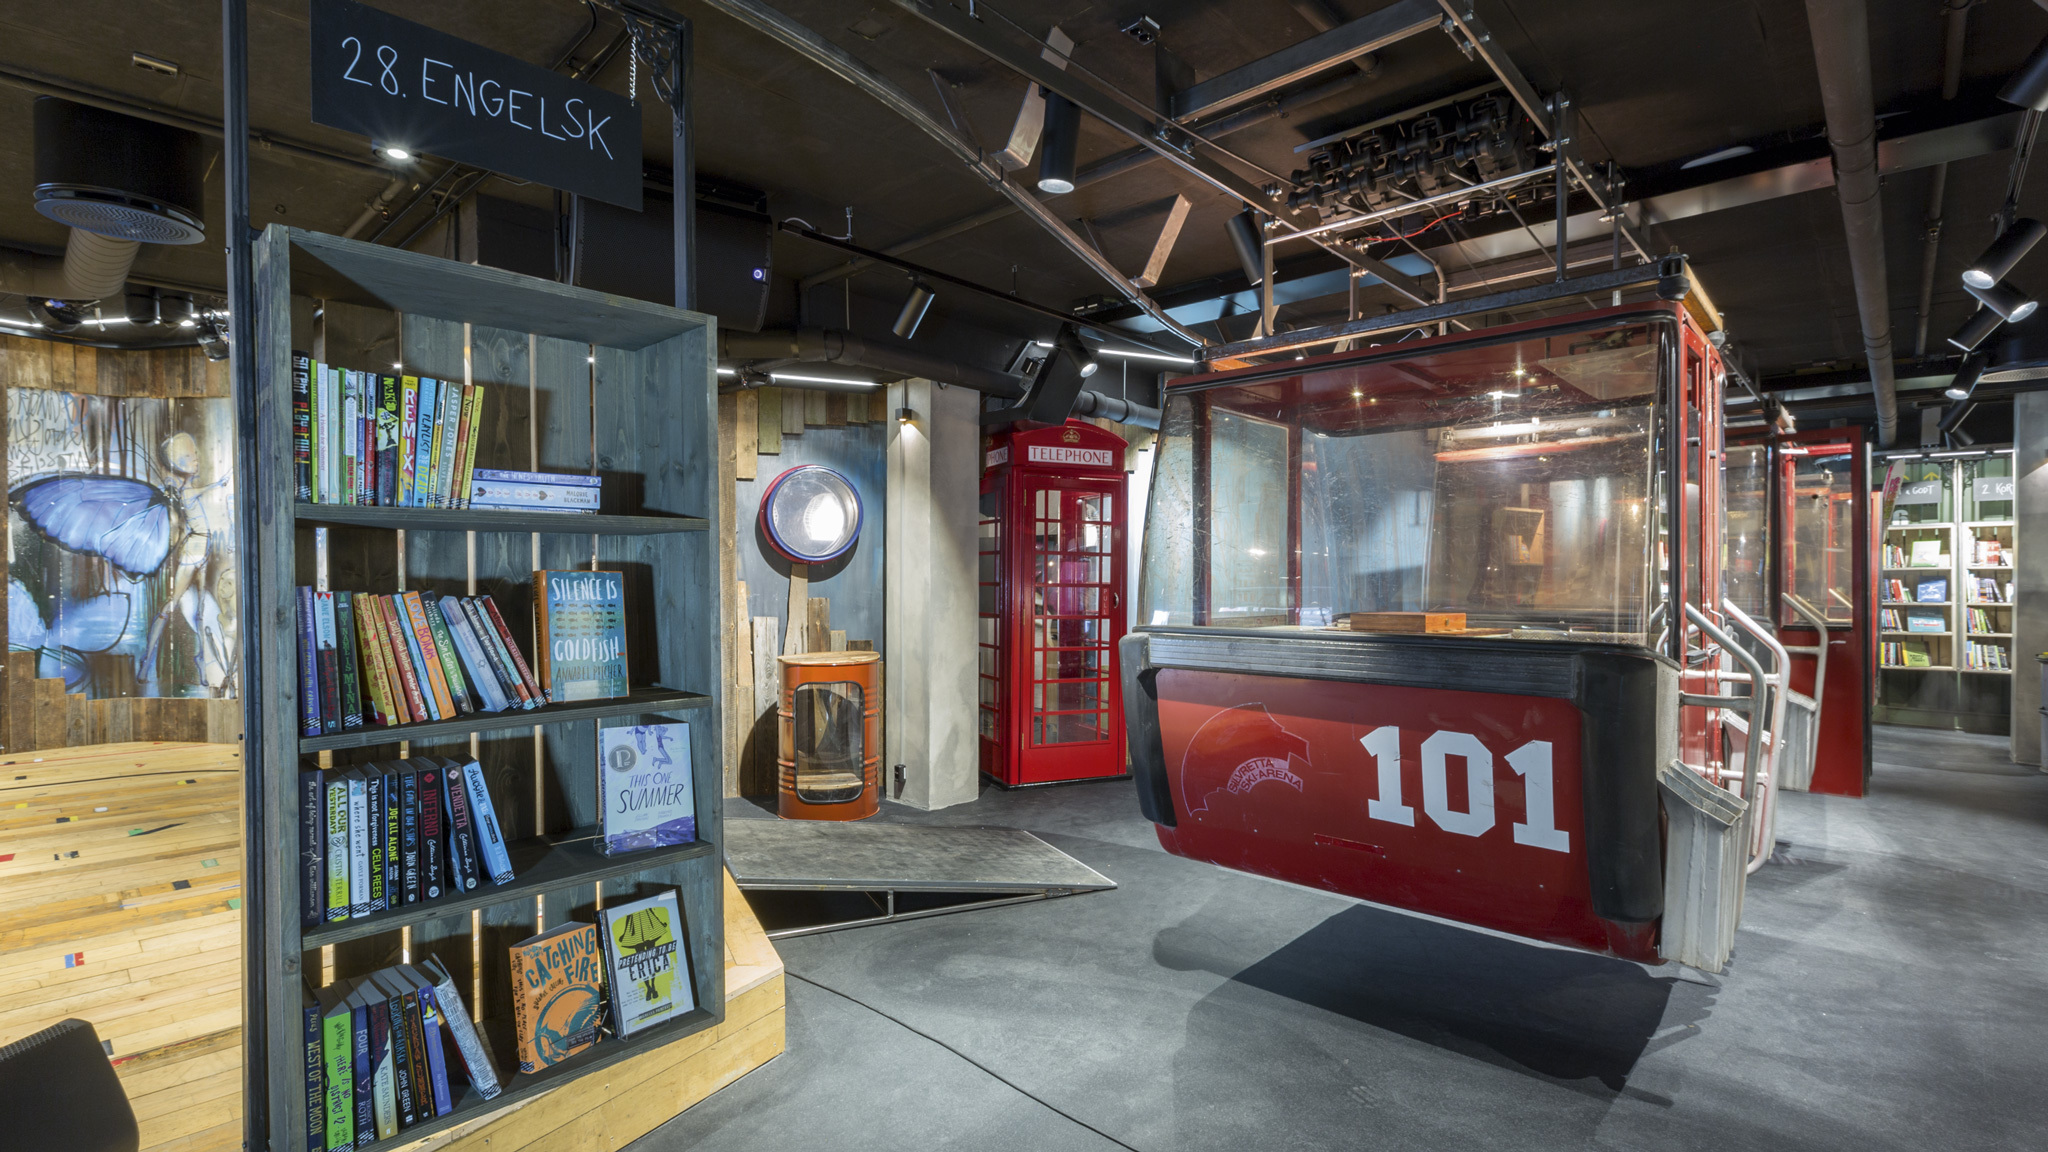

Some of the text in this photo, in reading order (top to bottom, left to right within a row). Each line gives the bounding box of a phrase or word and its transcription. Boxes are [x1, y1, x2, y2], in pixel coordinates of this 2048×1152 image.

[342, 36, 614, 161] 28. ENGELSK
[293, 355, 308, 370] 50
[383, 377, 398, 412] NAKED
[463, 399, 473, 418] Now
[402, 388, 417, 472] REMIX
[422, 414, 431, 454] PLAYLIST
[446, 387, 458, 458] JASPER JONES
[1031, 447, 1109, 464] TELEPHONE
[418, 466, 428, 494] DEAD
[566, 490, 588, 498] MALORIE
[1912, 484, 1935, 495] GODT
[1981, 484, 1990, 495] 2
[551, 577, 618, 601] SILENCE IS
[320, 598, 330, 639] JANE ELSON
[406, 595, 427, 629] LOVE
[424, 600, 436, 627] Salisbury
[429, 600, 441, 624] Melinda
[376, 621, 390, 644] bindi
[389, 619, 407, 651] bollywood
[416, 627, 437, 660] BOMB
[340, 611, 356, 714] MY NAME IS MINA
[505, 636, 535, 687] MORRIS GLEITZMAN
[554, 636, 620, 663] GOLDFISH
[438, 639, 449, 653] Sin
[451, 674, 464, 698] Daughter
[556, 663, 624, 683] ANNABEL PITCHER
[368, 779, 379, 794] This
[404, 775, 414, 788] THE
[629, 771, 673, 788] THIS ONE
[1228, 758, 1275, 793] SILVRETTA
[1240, 768, 1301, 791] SKI-ARENA
[1359, 724, 1570, 854] 101
[329, 787, 337, 834] YESTERDAYS
[337, 787, 347, 832] ALL OUR
[423, 788, 438, 837] INFERNO
[450, 783, 467, 829] VENDETTA
[616, 783, 684, 814] SUMMER
[354, 801, 365, 857] where she went
[370, 813, 379, 846] forgiveness
[389, 807, 398, 862] JOE ALL ALONE
[372, 848, 381, 898] CELIA REES
[405, 850, 417, 890] JOHN GREEN
[525, 928, 595, 989] CATCHING
[564, 956, 599, 985] FIRE
[618, 949, 657, 968] PRETENDING
[629, 957, 671, 982] ERICA
[389, 999, 402, 1030] LOOKING
[307, 1040, 321, 1068] WEST
[356, 1029, 368, 1056] FOUR
[394, 1038, 406, 1064] ALASKA
[308, 1070, 321, 1083] OF
[398, 1068, 411, 1113] JOHN GREEN
[308, 1083, 322, 1107] THE
[330, 1085, 343, 1114] DISTRICT
[382, 1087, 391, 1125] SAUNDERS
[309, 1106, 322, 1135] MOON
[358, 1101, 367, 1126] ROTH
